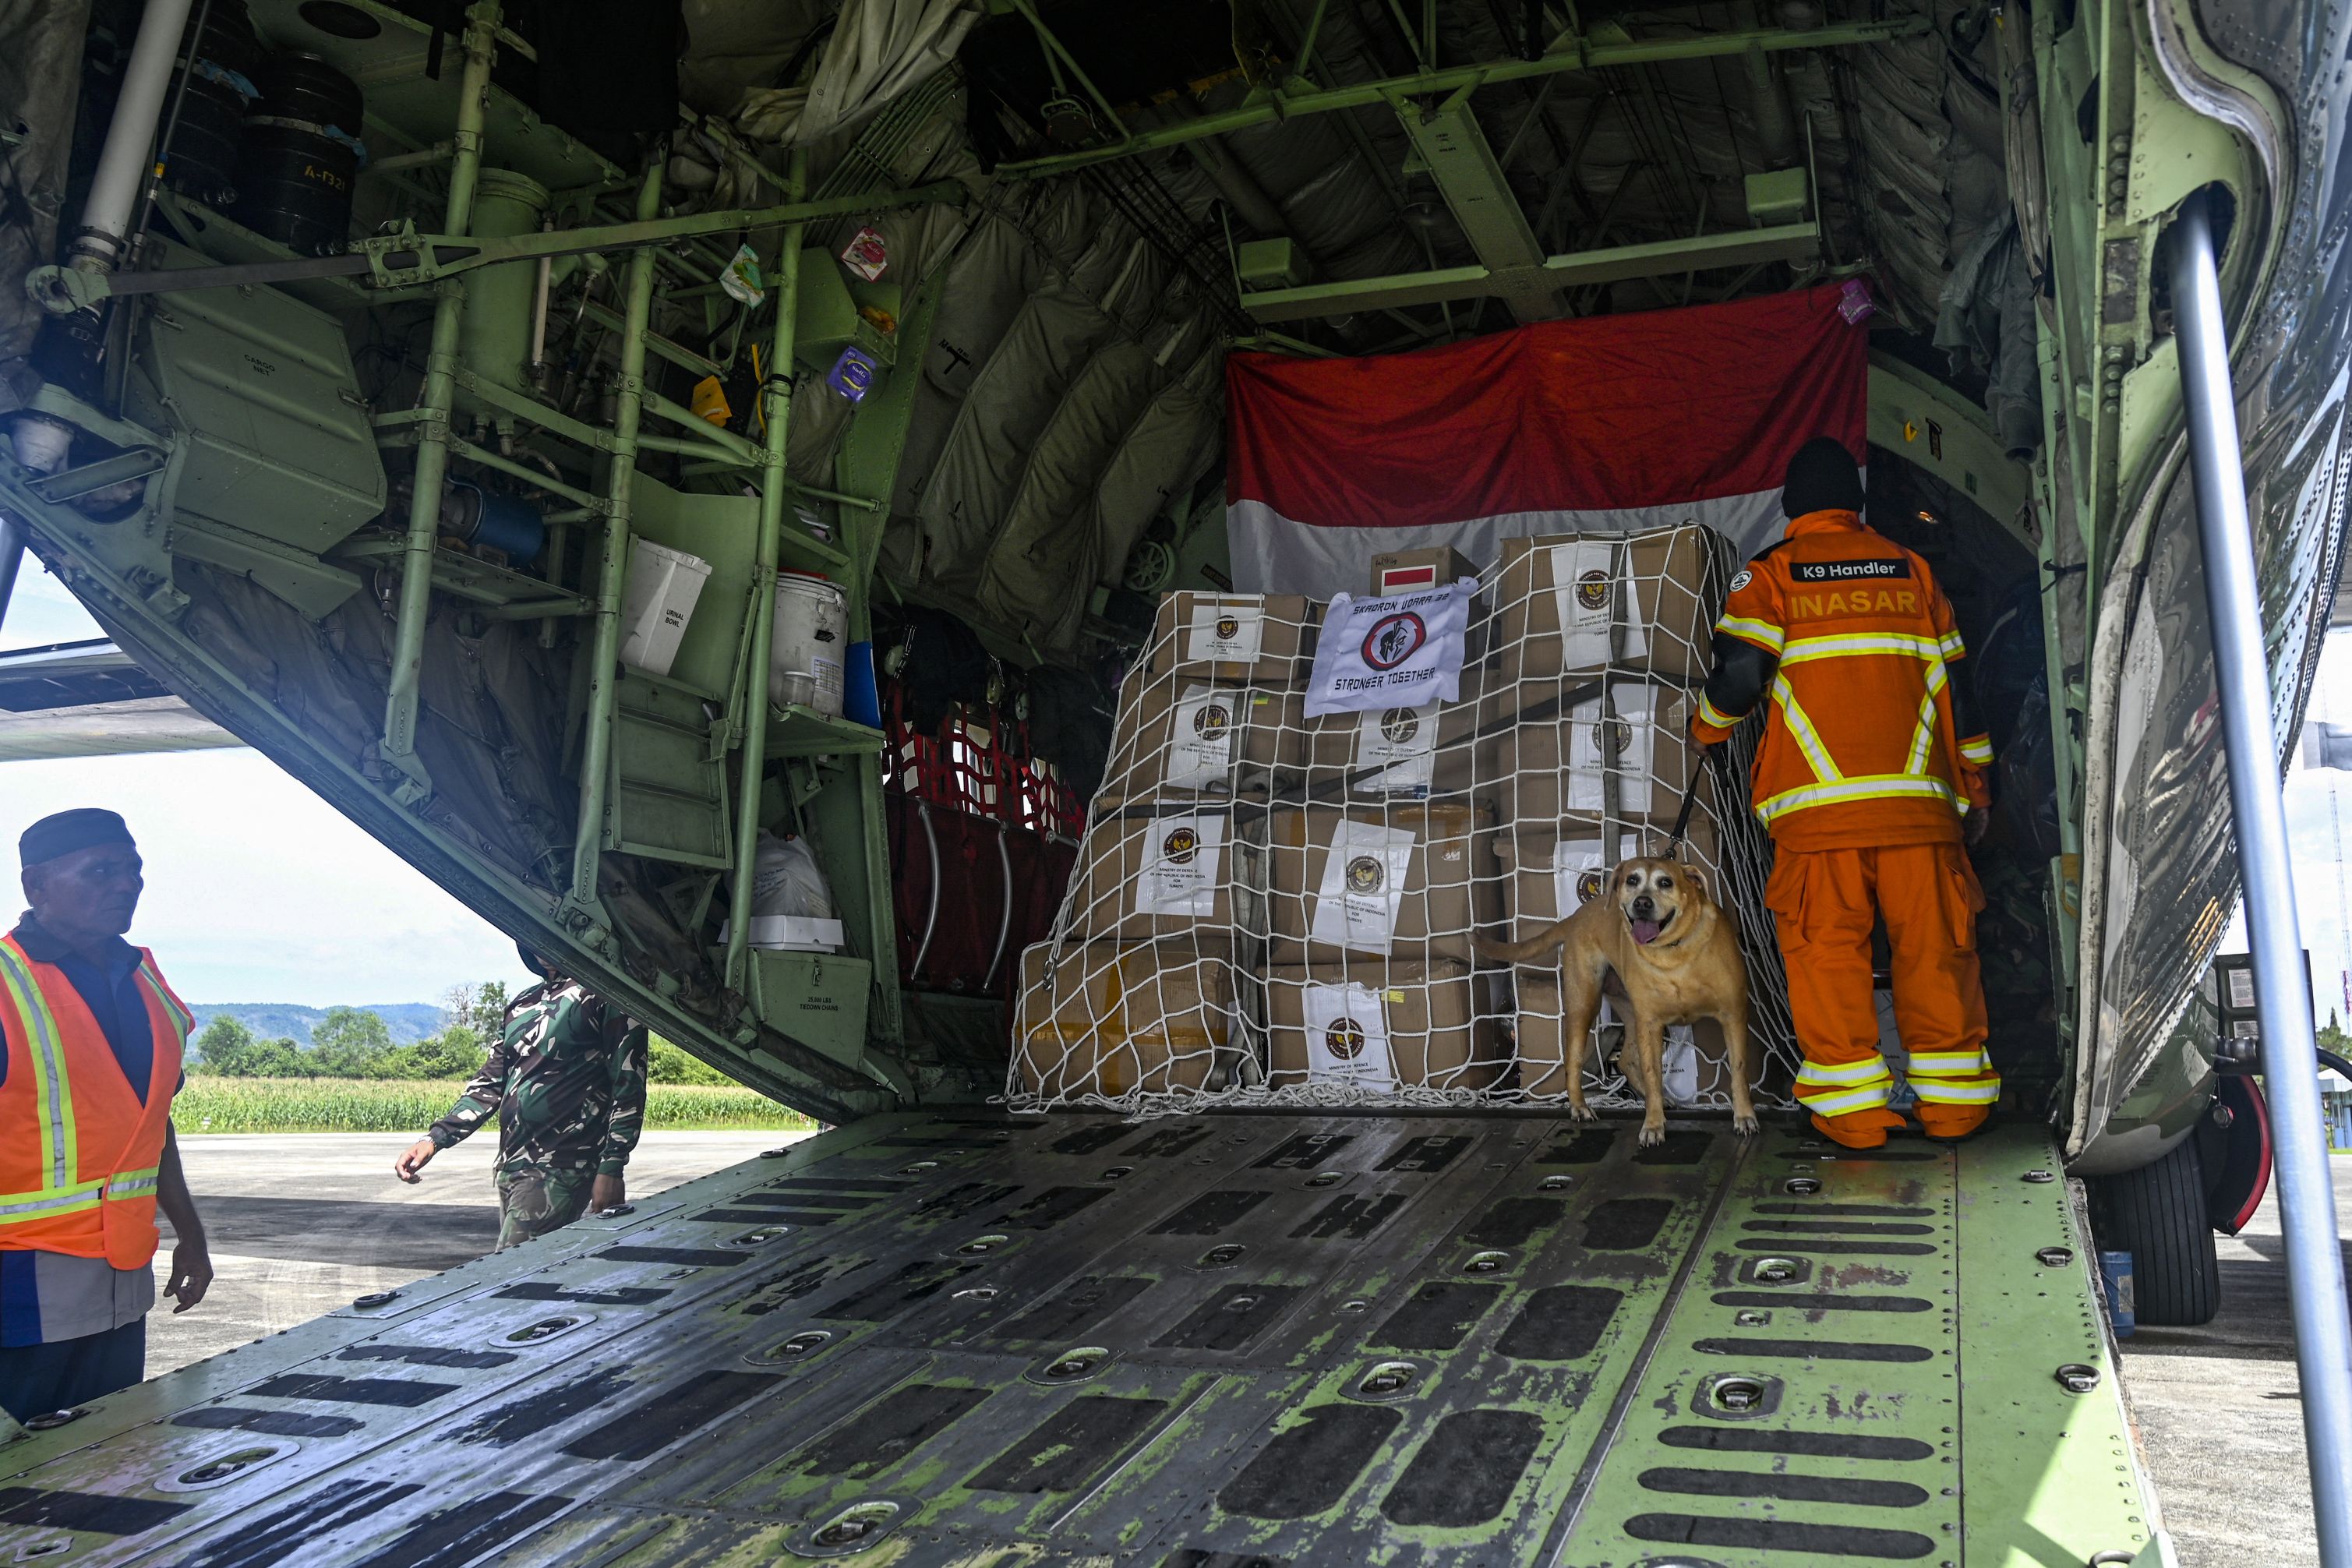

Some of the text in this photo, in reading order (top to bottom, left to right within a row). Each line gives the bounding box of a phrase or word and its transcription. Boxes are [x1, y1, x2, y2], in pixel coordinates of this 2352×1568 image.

[244, 355, 275, 372] CARGO
[253, 365, 269, 376] NET
[852, 366, 866, 379] Stella
[1803, 562, 1896, 578] K9 Handler
[1435, 592, 1449, 602] 32
[1791, 590, 1916, 618] INASAR
[666, 609, 684, 620] URINAL
[665, 616, 680, 627] BOWL
[1335, 667, 1436, 691] STRONGER TOGETHER
